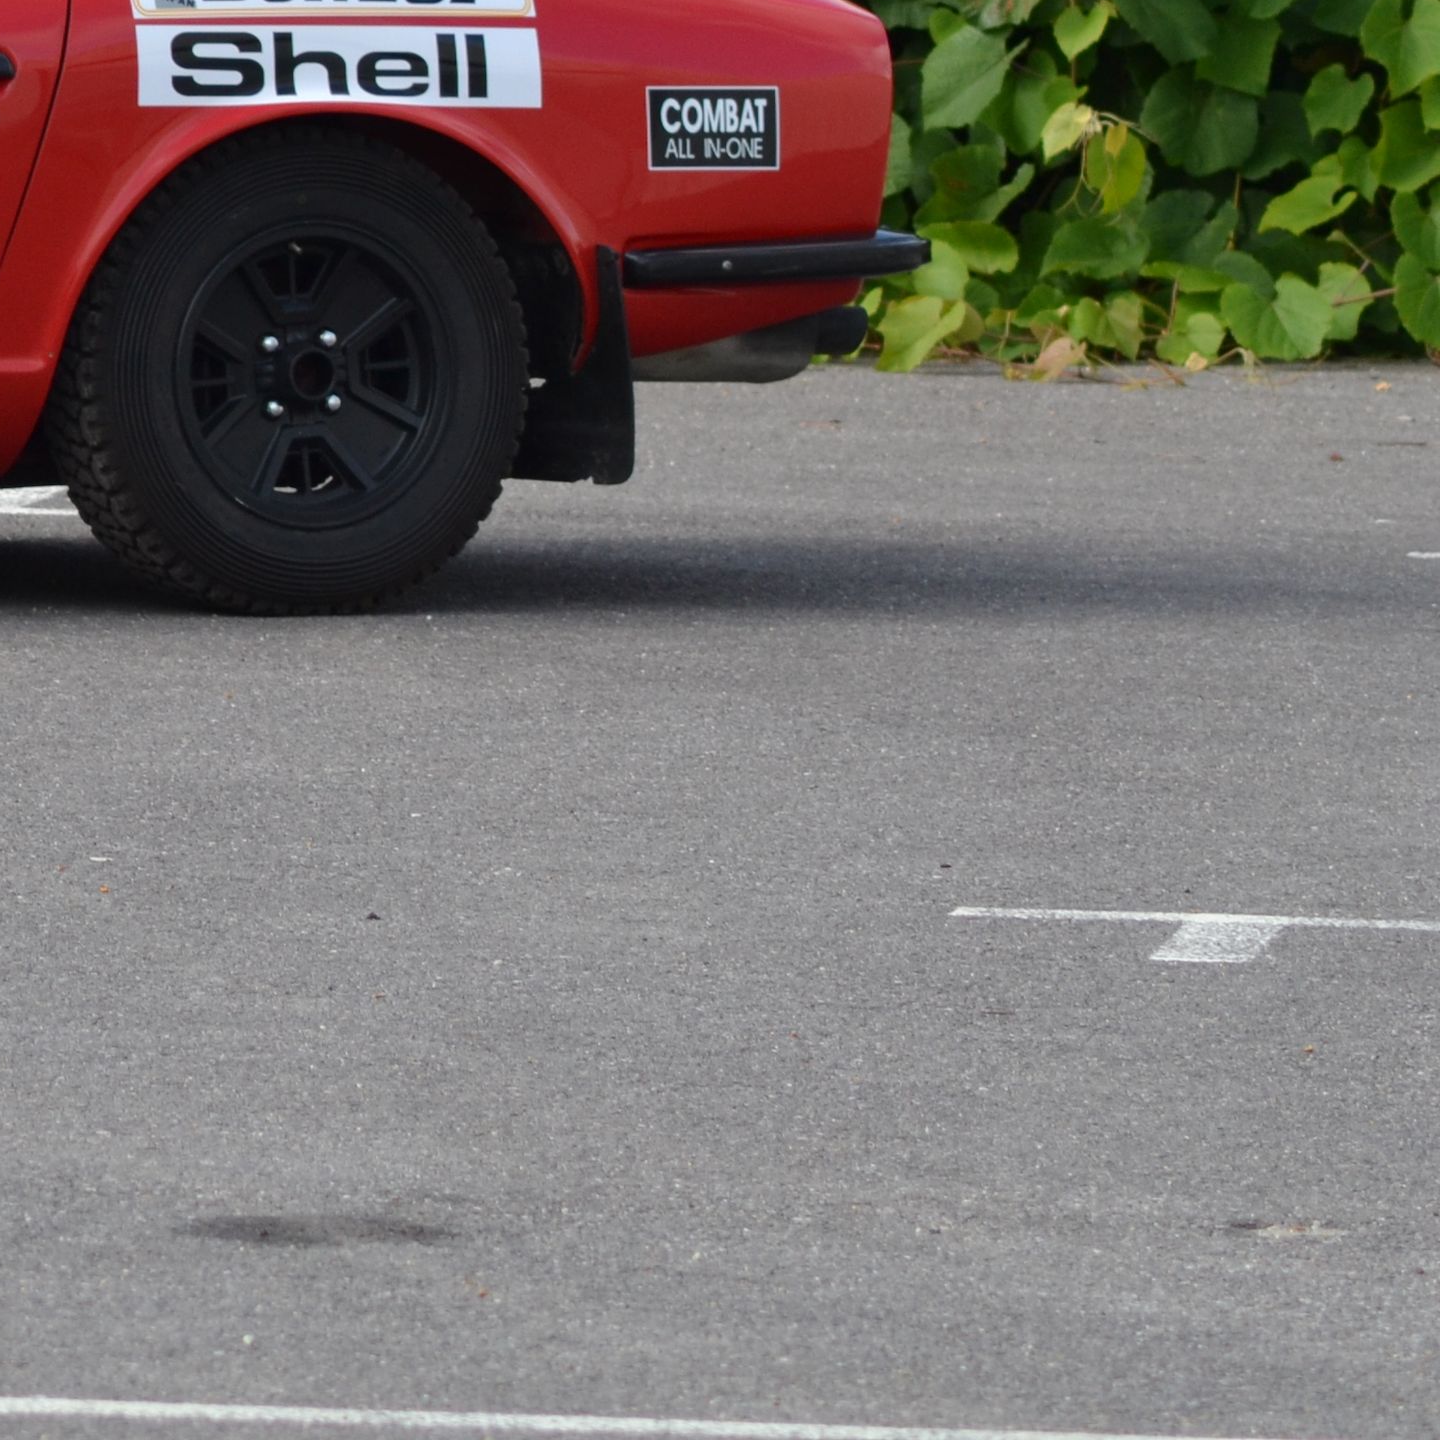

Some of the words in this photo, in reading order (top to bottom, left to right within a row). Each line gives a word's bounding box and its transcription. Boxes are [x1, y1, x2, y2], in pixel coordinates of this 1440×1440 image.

[170, 31, 489, 97] Shell
[660, 97, 768, 134] COMBAT
[664, 137, 696, 160] ALL
[703, 136, 764, 160] IN-ONE
